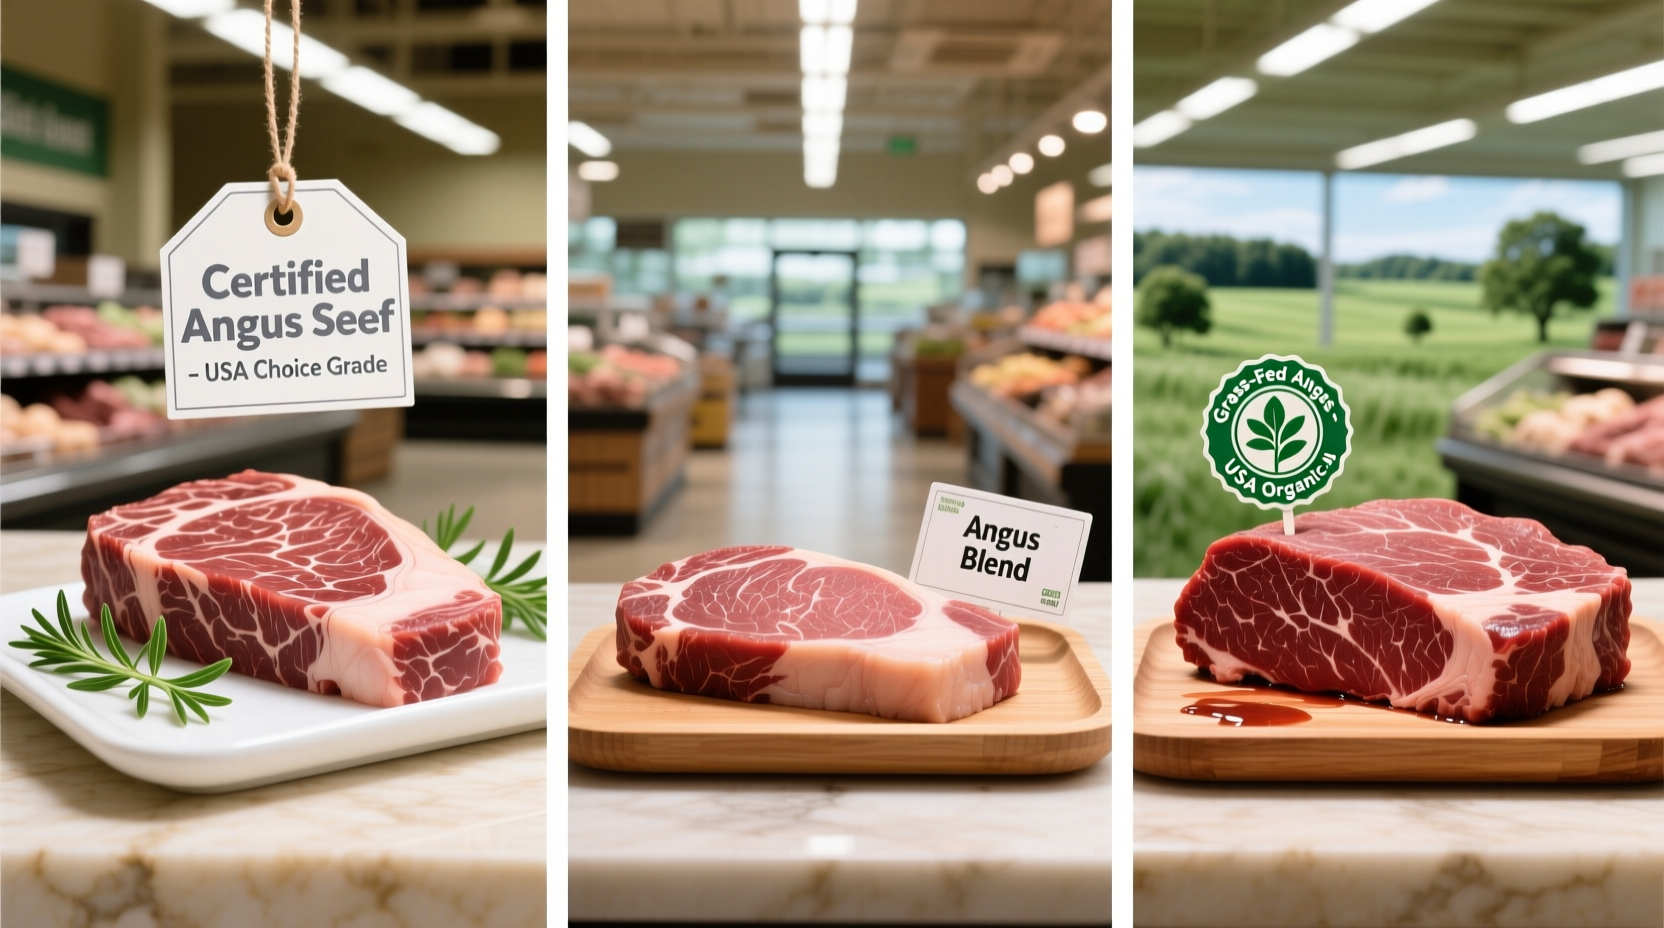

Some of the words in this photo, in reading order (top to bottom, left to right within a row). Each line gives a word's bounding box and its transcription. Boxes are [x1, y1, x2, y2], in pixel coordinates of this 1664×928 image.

[202, 258, 370, 300] Certified
[181, 308, 304, 351] Angus
[312, 298, 396, 337] Seef
[205, 361, 249, 382] USA
[253, 358, 322, 380] Choice
[326, 354, 388, 376] Grade
[1213, 366, 1288, 423] Grass-Fed
[1225, 458, 1256, 493] USA
[962, 515, 1041, 551] Angus
[960, 545, 1032, 582] Blend
